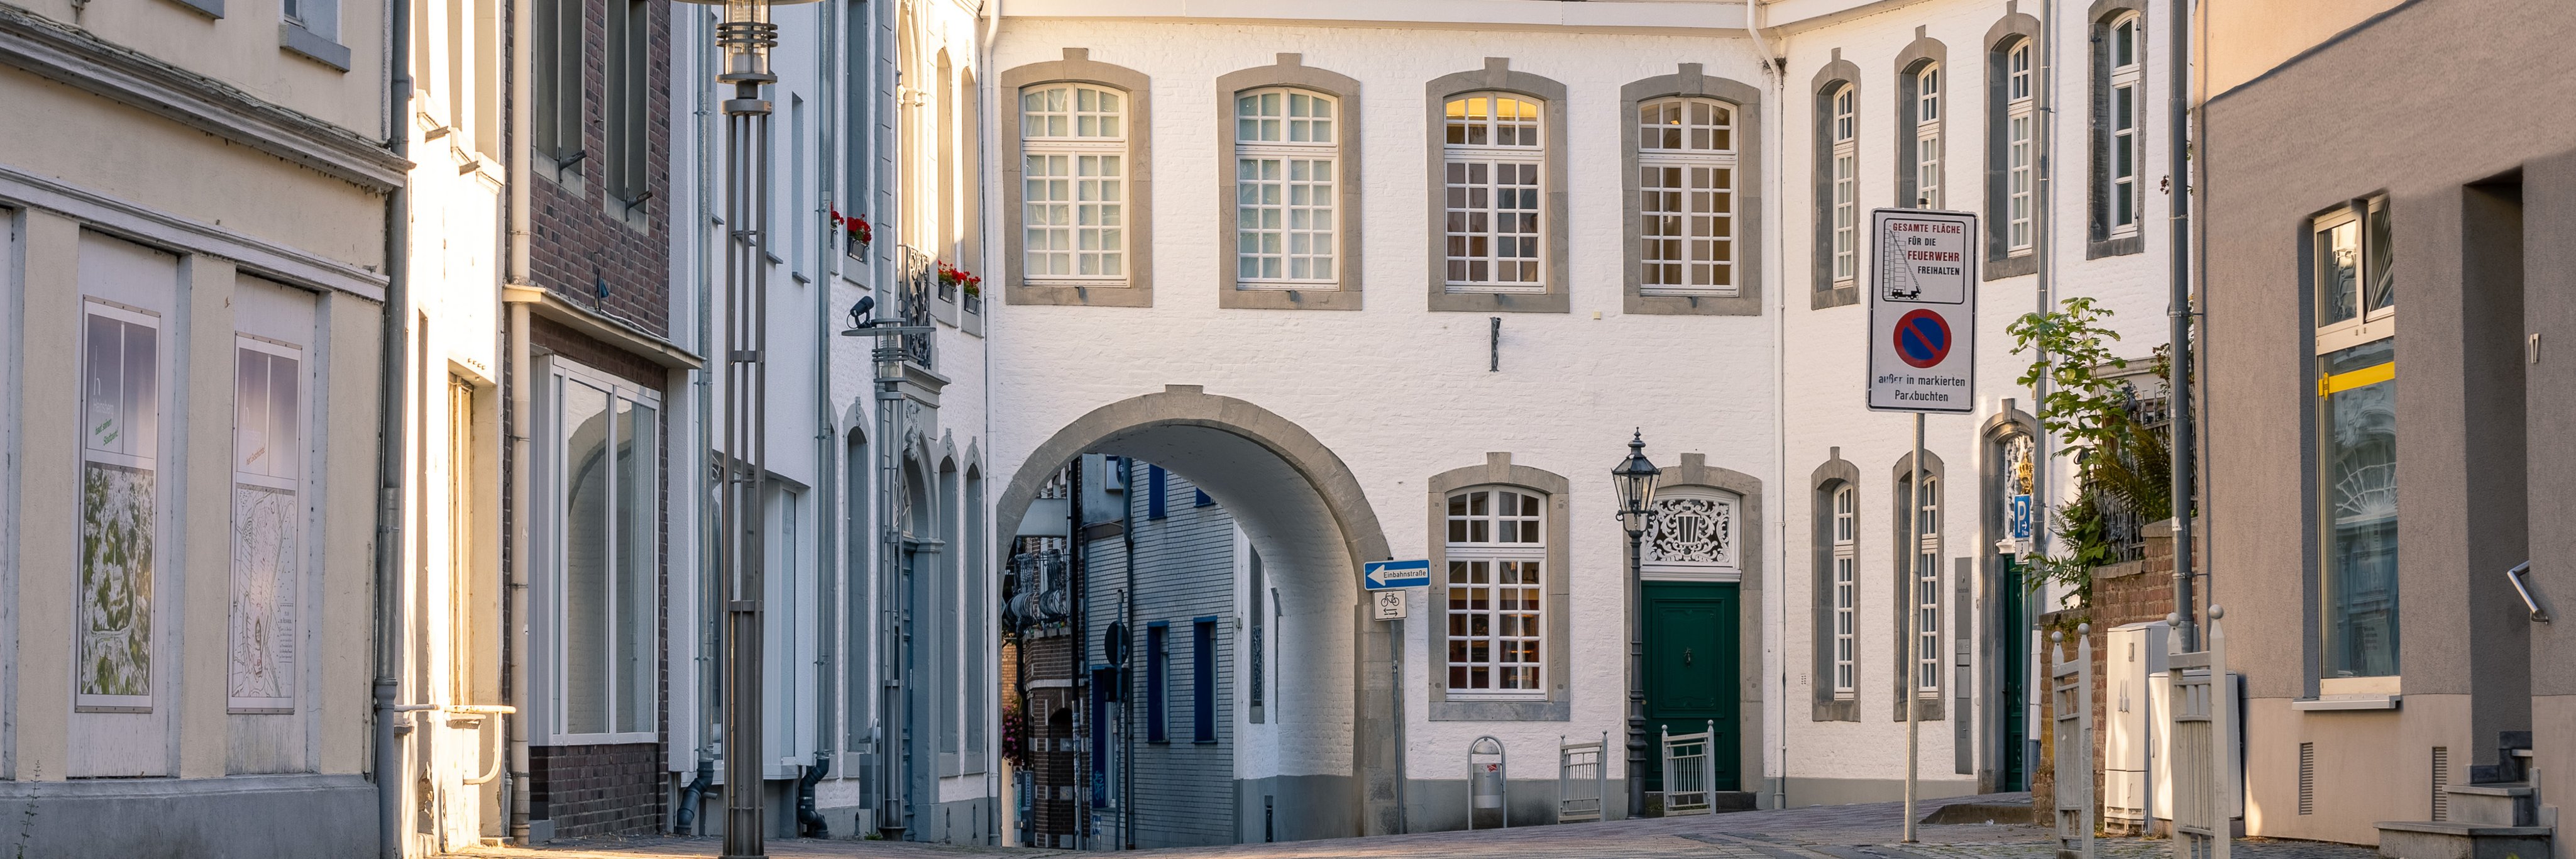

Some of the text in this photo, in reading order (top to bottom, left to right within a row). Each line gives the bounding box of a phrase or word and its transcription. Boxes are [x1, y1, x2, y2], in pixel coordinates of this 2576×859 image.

[1893, 223, 1961, 234] GESAMTE FLÄCHE
[1908, 236, 1936, 246] FÜR DIE
[1907, 250, 1960, 262] FEUERWEHR
[1917, 266, 1960, 275] FREIHALTEN
[2528, 333, 2539, 363] 17
[1907, 374, 1914, 384] in
[1918, 375, 1966, 387] markierten
[2018, 501, 2026, 533] P
[1384, 570, 1426, 579] Einbahnstraße
